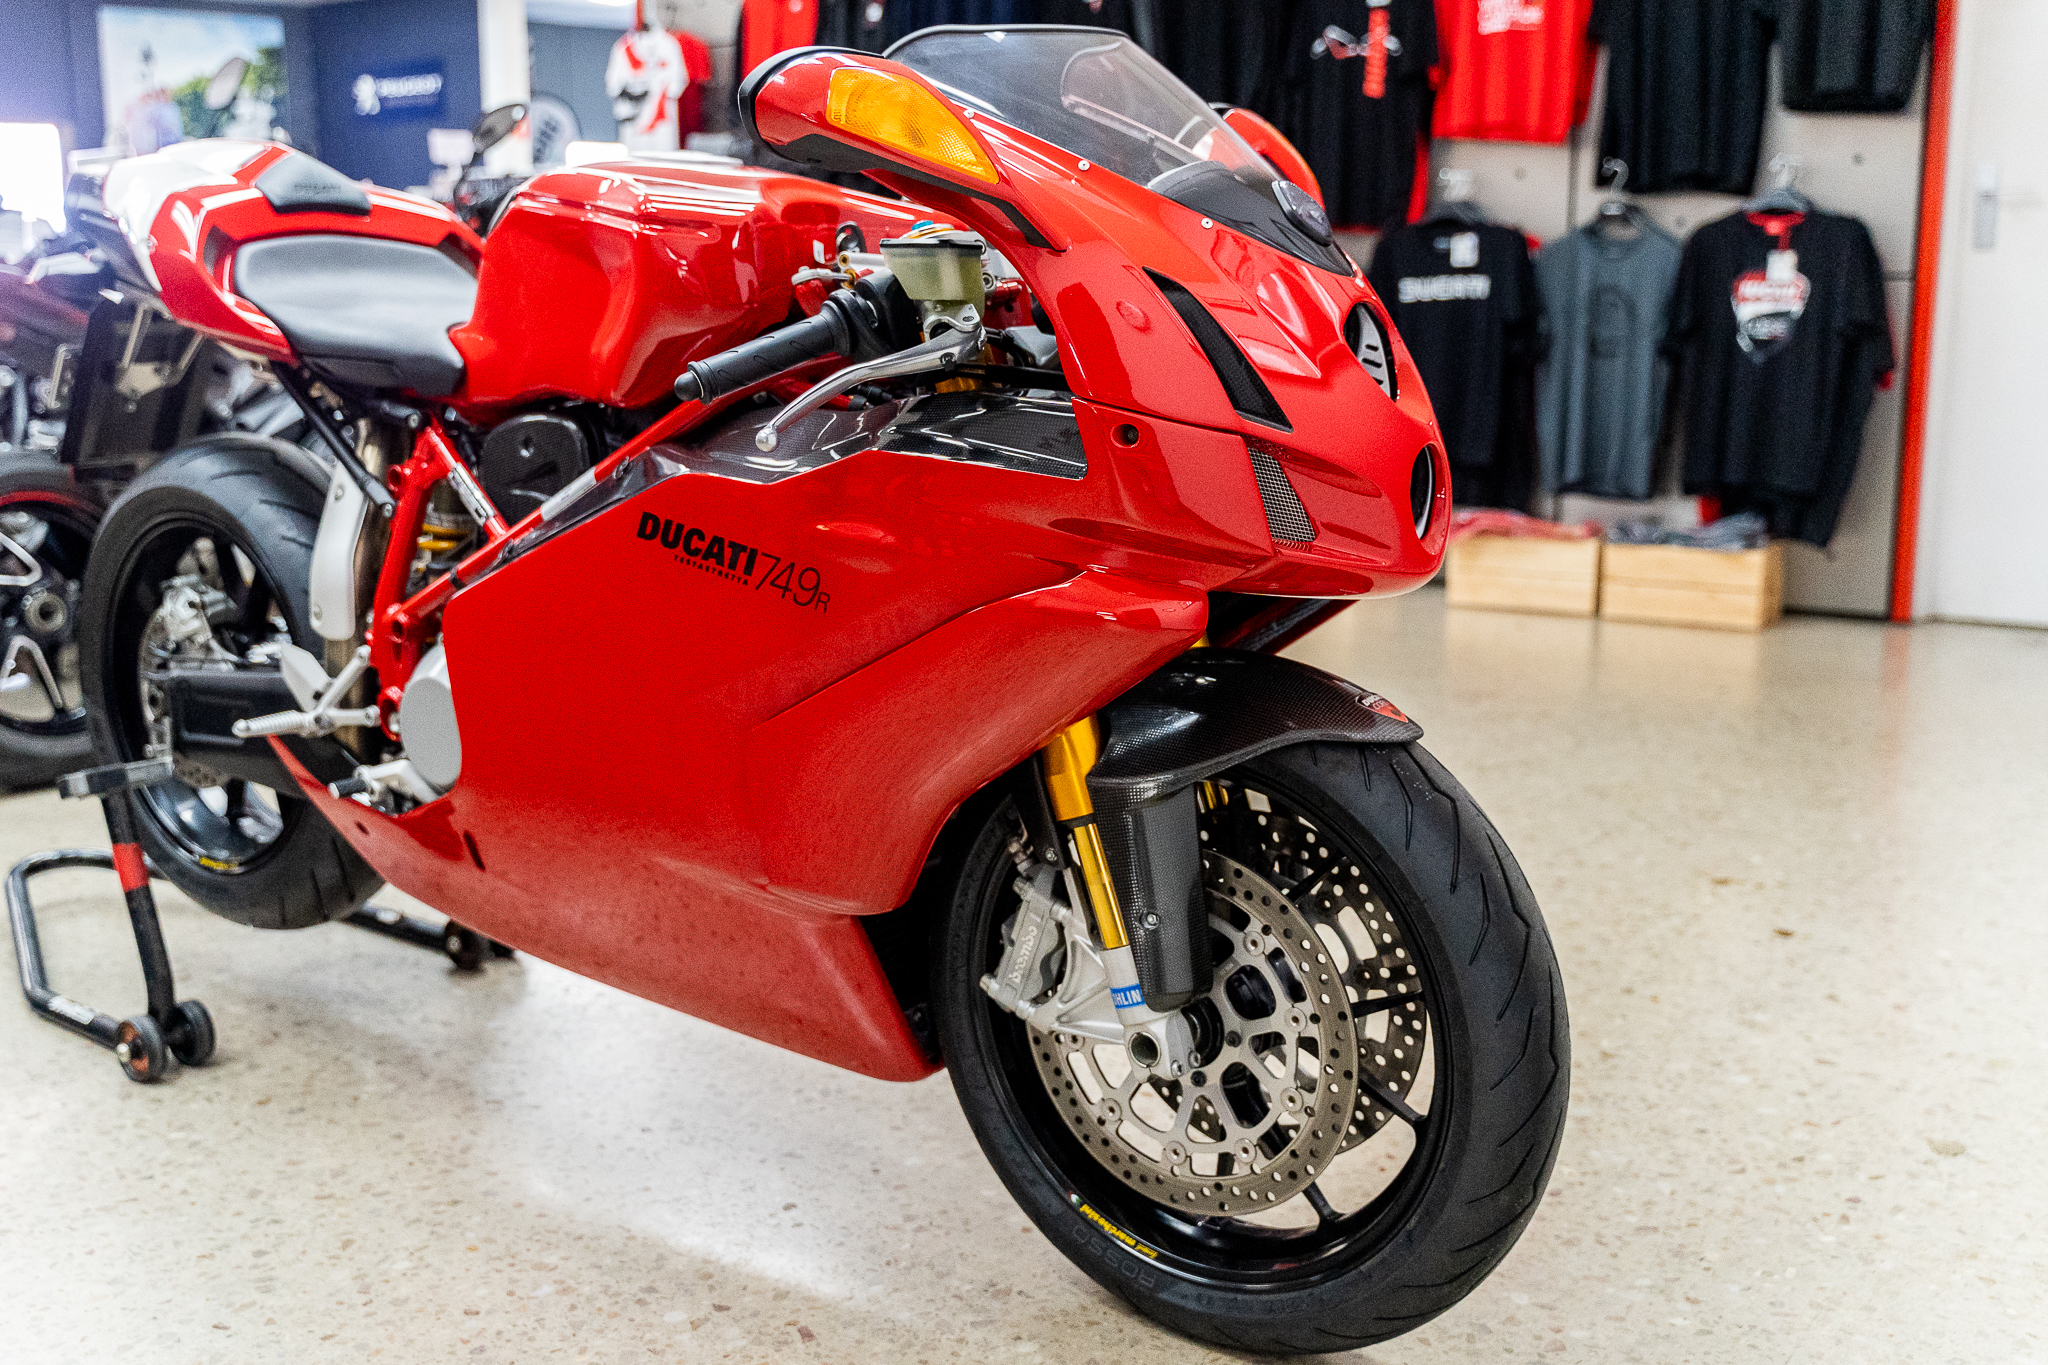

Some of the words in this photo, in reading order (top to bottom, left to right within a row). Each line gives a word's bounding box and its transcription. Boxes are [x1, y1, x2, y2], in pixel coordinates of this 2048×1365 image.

[636, 511, 759, 577] DUCATI
[674, 554, 749, 586] TESTASTRETTA
[1008, 925, 1038, 984] brembo
[1080, 1203, 1136, 1246] marchesini
